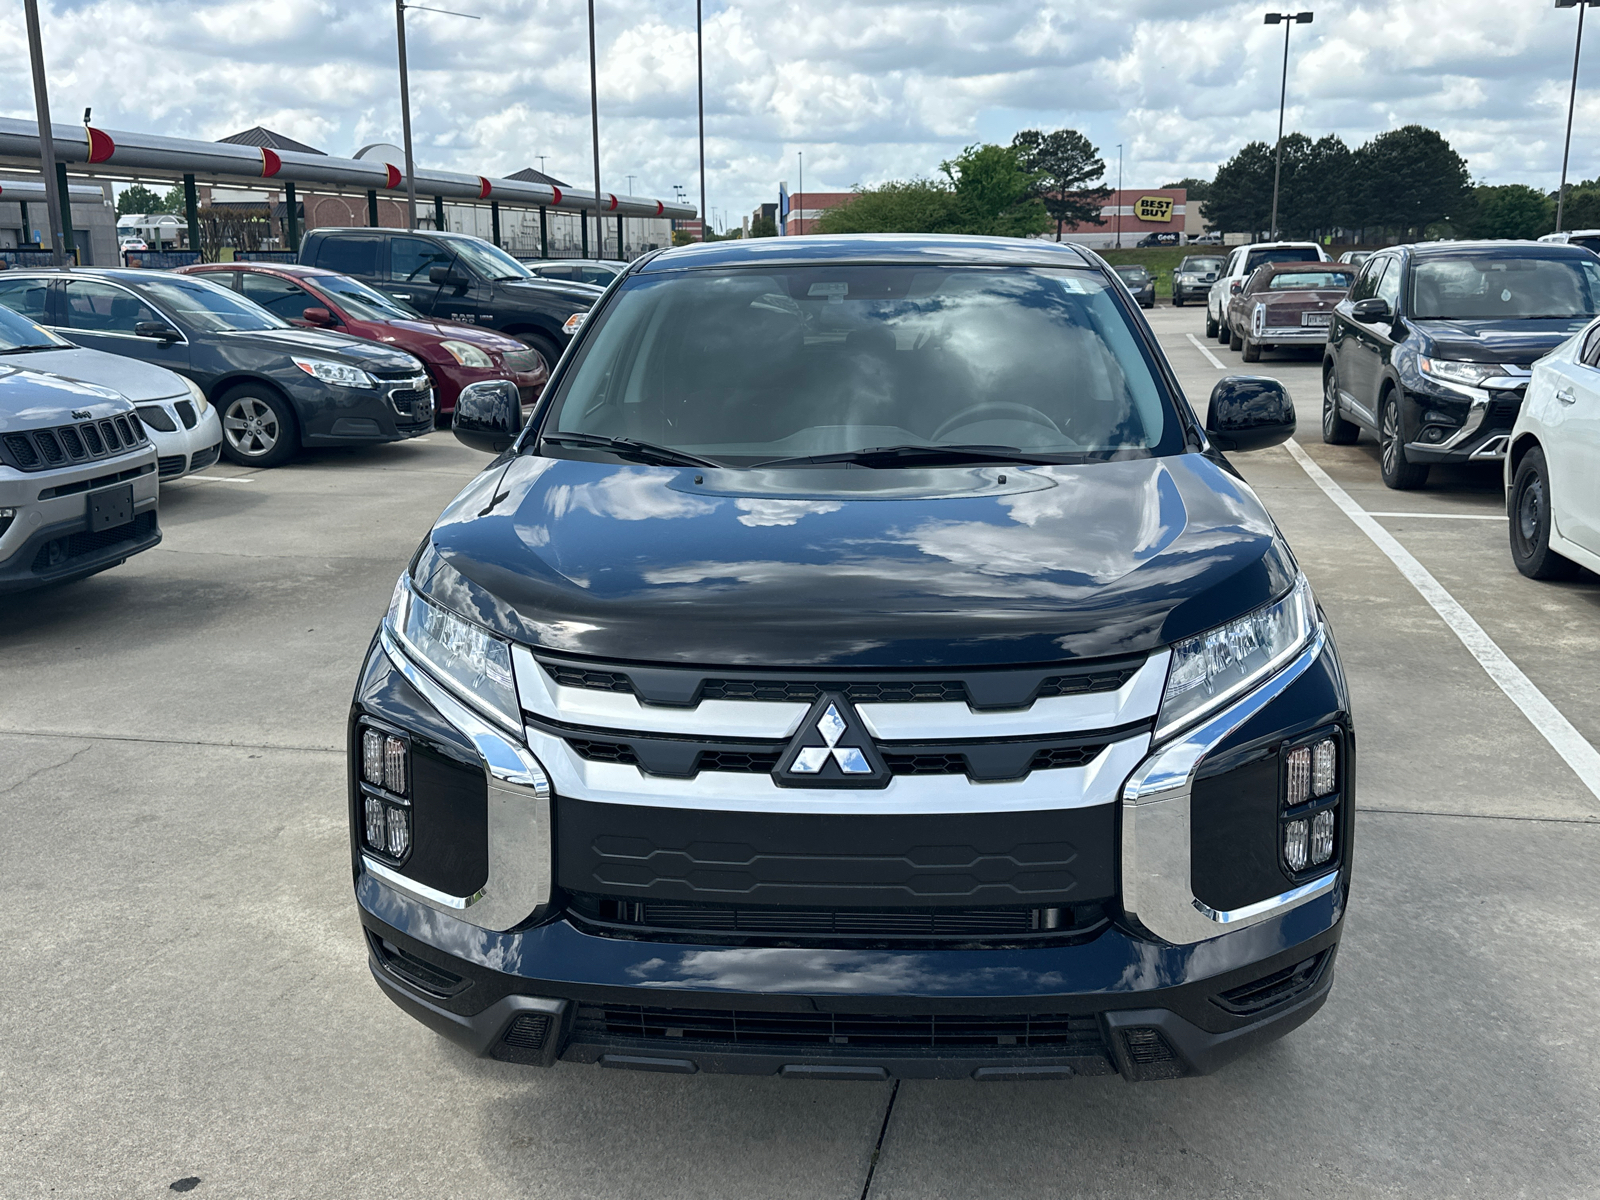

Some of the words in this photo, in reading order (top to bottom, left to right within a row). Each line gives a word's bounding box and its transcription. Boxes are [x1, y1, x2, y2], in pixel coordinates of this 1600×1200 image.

[1140, 200, 1172, 209] BEST
[1141, 208, 1168, 218] BUY
[71, 410, 92, 420] Jeep
